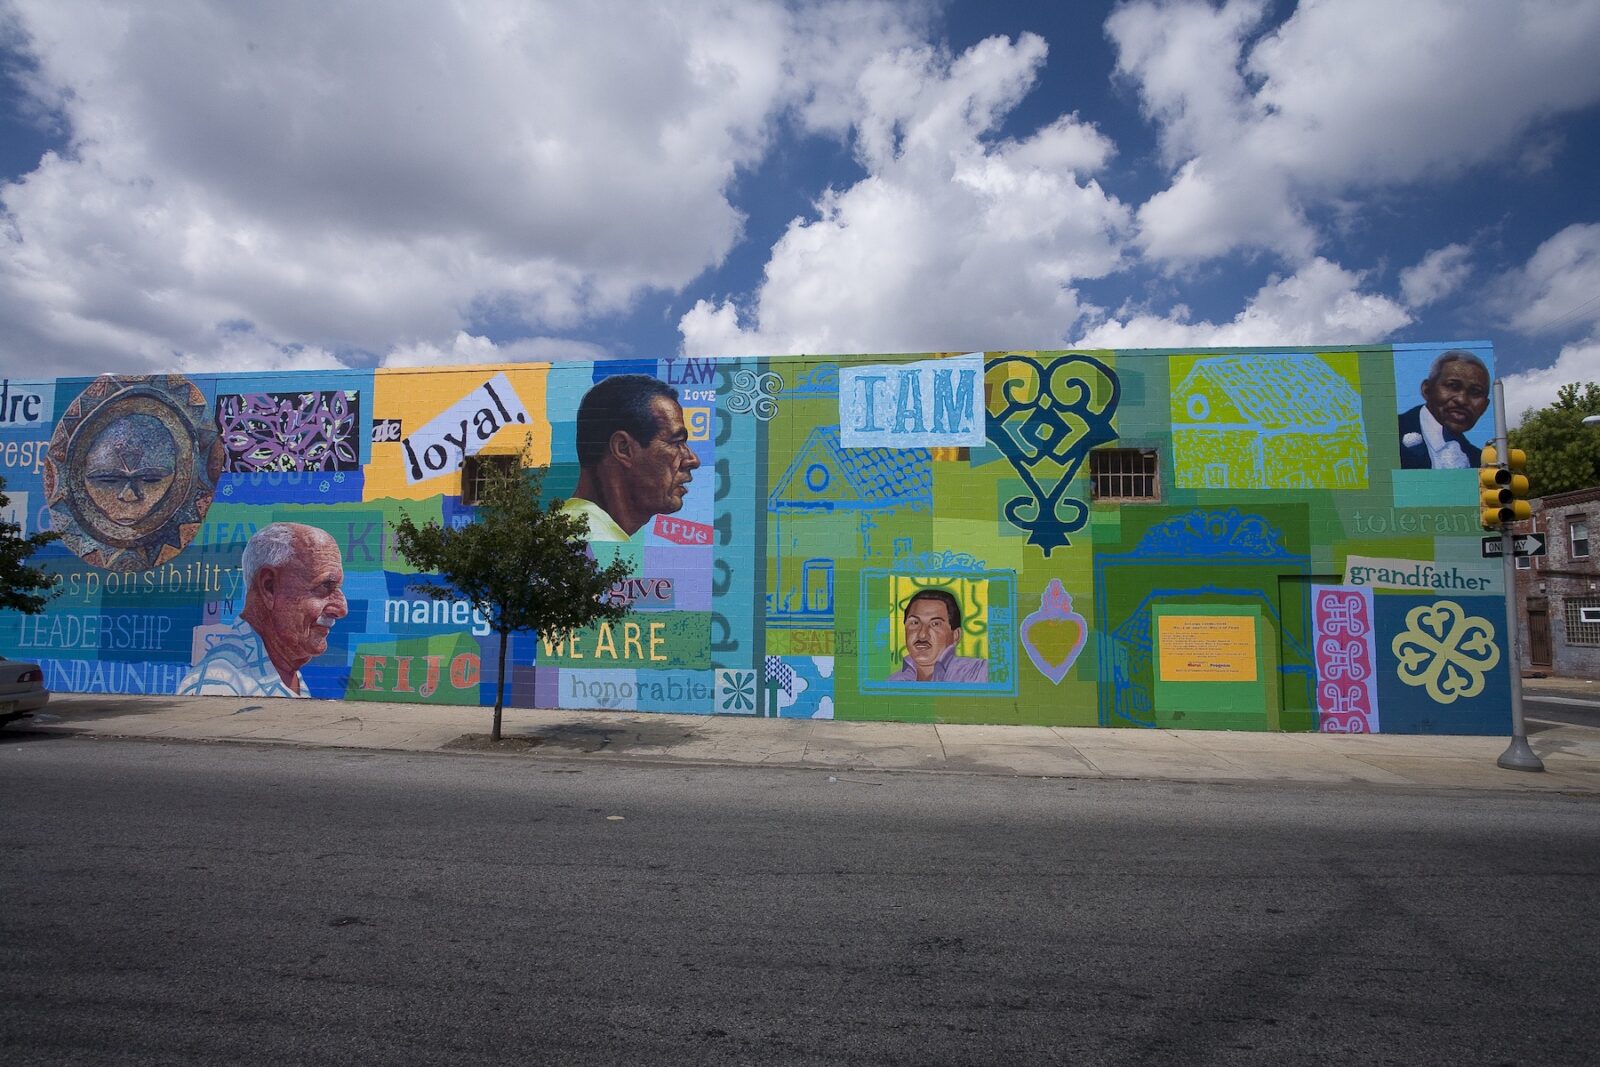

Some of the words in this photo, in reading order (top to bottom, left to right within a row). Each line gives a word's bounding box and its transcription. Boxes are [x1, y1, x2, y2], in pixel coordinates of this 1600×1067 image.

[664, 357, 717, 385] LAW
[854, 375, 887, 433] I
[891, 368, 977, 434] AM
[402, 381, 526, 480] loyal.
[661, 519, 708, 545] true
[1350, 563, 1491, 591] grandfather
[18, 614, 171, 650] LEADERSHIP
[594, 622, 668, 661] ARE
[360, 652, 480, 698] FIJO
